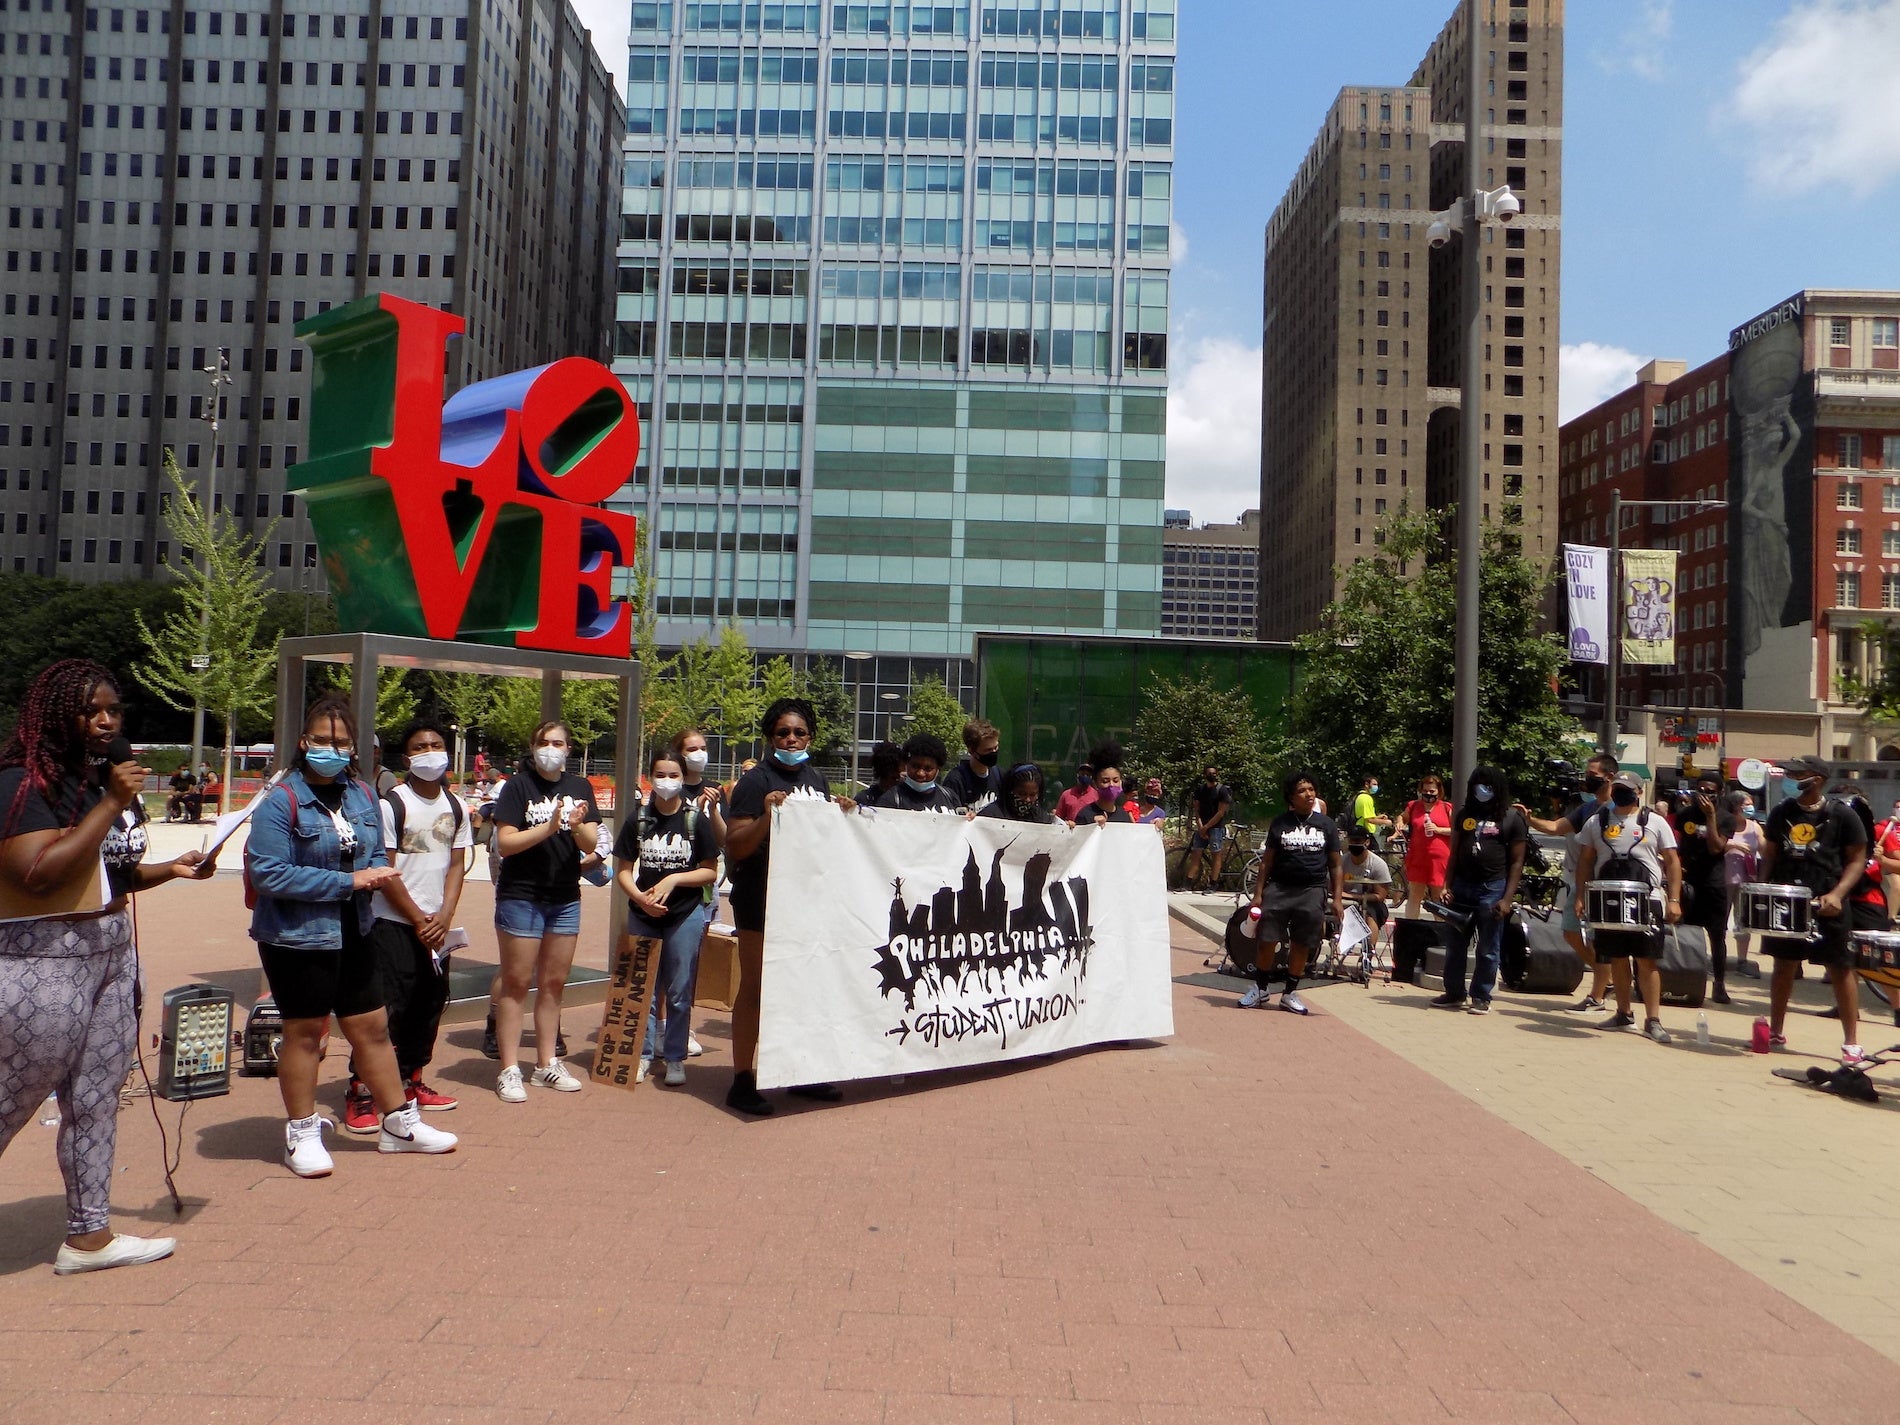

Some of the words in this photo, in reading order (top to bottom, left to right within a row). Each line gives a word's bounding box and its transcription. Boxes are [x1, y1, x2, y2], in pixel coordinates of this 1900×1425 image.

[1740, 298, 1801, 346] MERIDIEN
[1567, 552, 1594, 569] COZY
[1568, 567, 1580, 583] IN
[1570, 584, 1597, 600] LOVE
[1573, 642, 1597, 652] LOVE
[1573, 650, 1597, 660] PARK
[1624, 892, 1638, 924] Pearl
[1773, 897, 1790, 931] Pearl
[614, 952, 633, 988] WAR
[628, 939, 652, 1003] AMERICA
[605, 997, 624, 1027] THE
[618, 1010, 641, 1056] BLACK
[596, 1033, 616, 1078] STOP
[614, 1064, 631, 1085] ON
